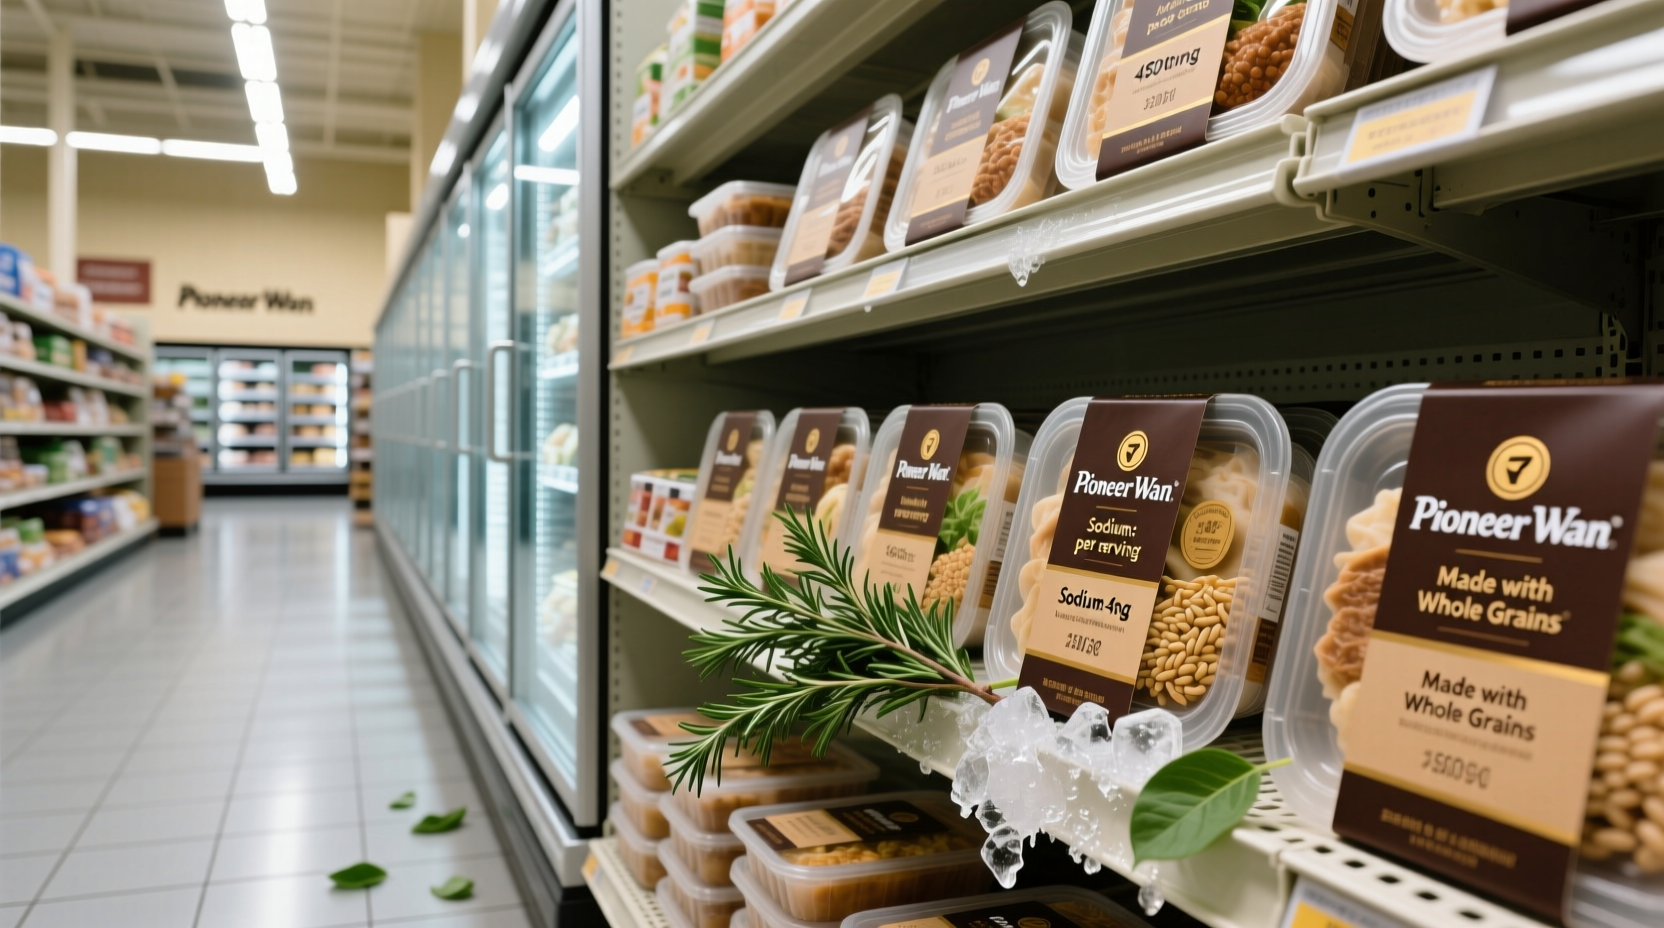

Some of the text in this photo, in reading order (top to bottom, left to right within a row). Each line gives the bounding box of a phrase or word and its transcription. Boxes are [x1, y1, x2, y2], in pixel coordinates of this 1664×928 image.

[1073, 470, 1173, 502] Pioneer Wan
[1409, 495, 1613, 550] Pioneer Wan
[1073, 538, 1097, 555] per
[1436, 565, 1554, 604] Made with
[1418, 589, 1562, 635] Whole Grains
[1421, 670, 1527, 711] Made with
[1405, 691, 1463, 723] Whole
[1468, 707, 1536, 741] Grains
